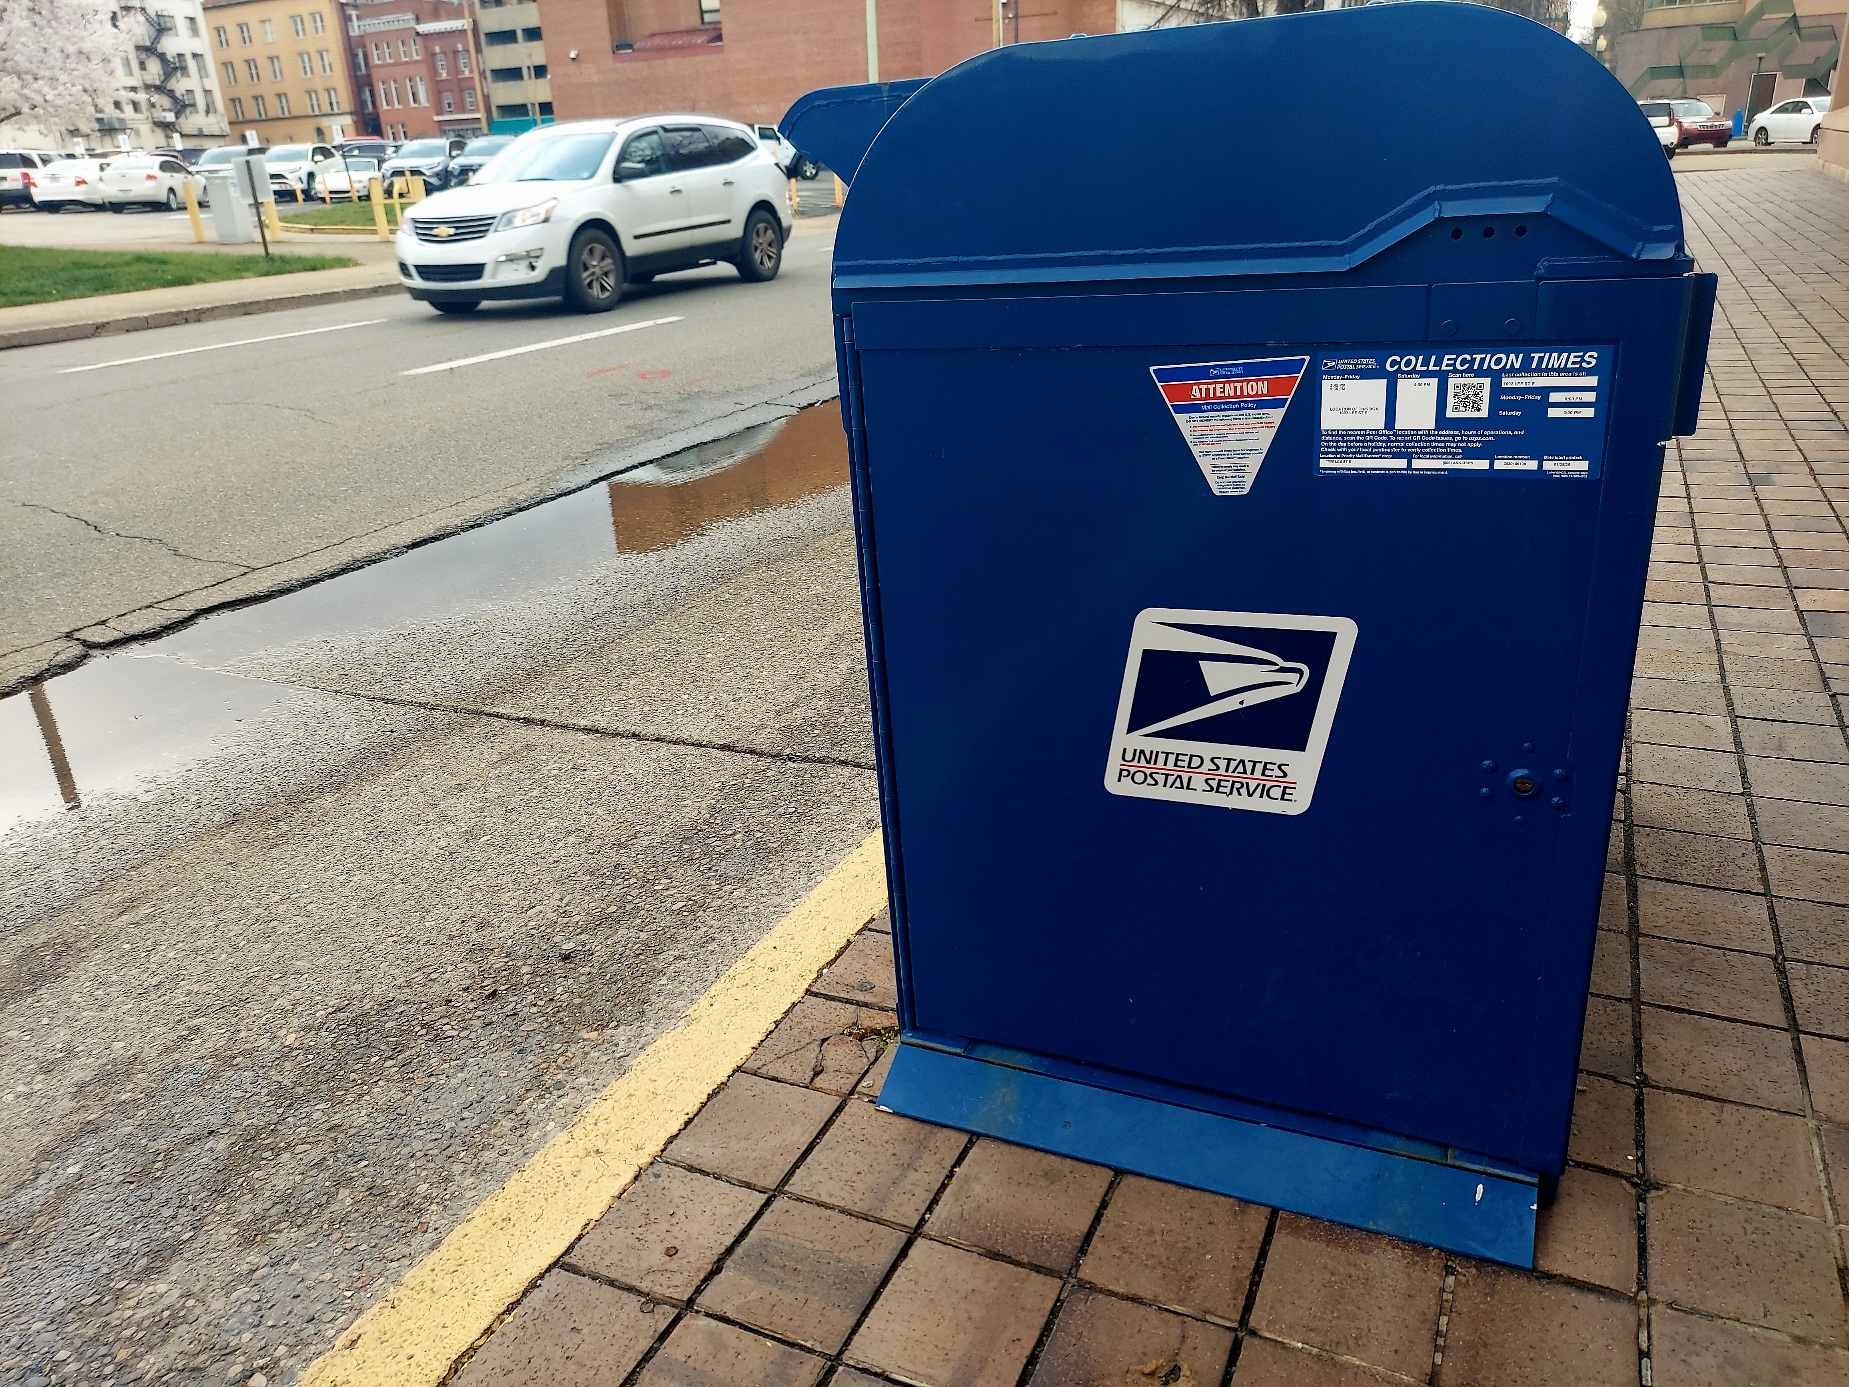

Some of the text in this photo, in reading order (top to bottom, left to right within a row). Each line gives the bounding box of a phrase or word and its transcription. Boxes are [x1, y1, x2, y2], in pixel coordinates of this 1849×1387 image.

[1385, 351, 1599, 372] COLLECTION TIMES
[1190, 380, 1268, 399] ATTENTION
[1121, 747, 1290, 779] UNITED STATES
[1117, 768, 1198, 792] POSTAL
